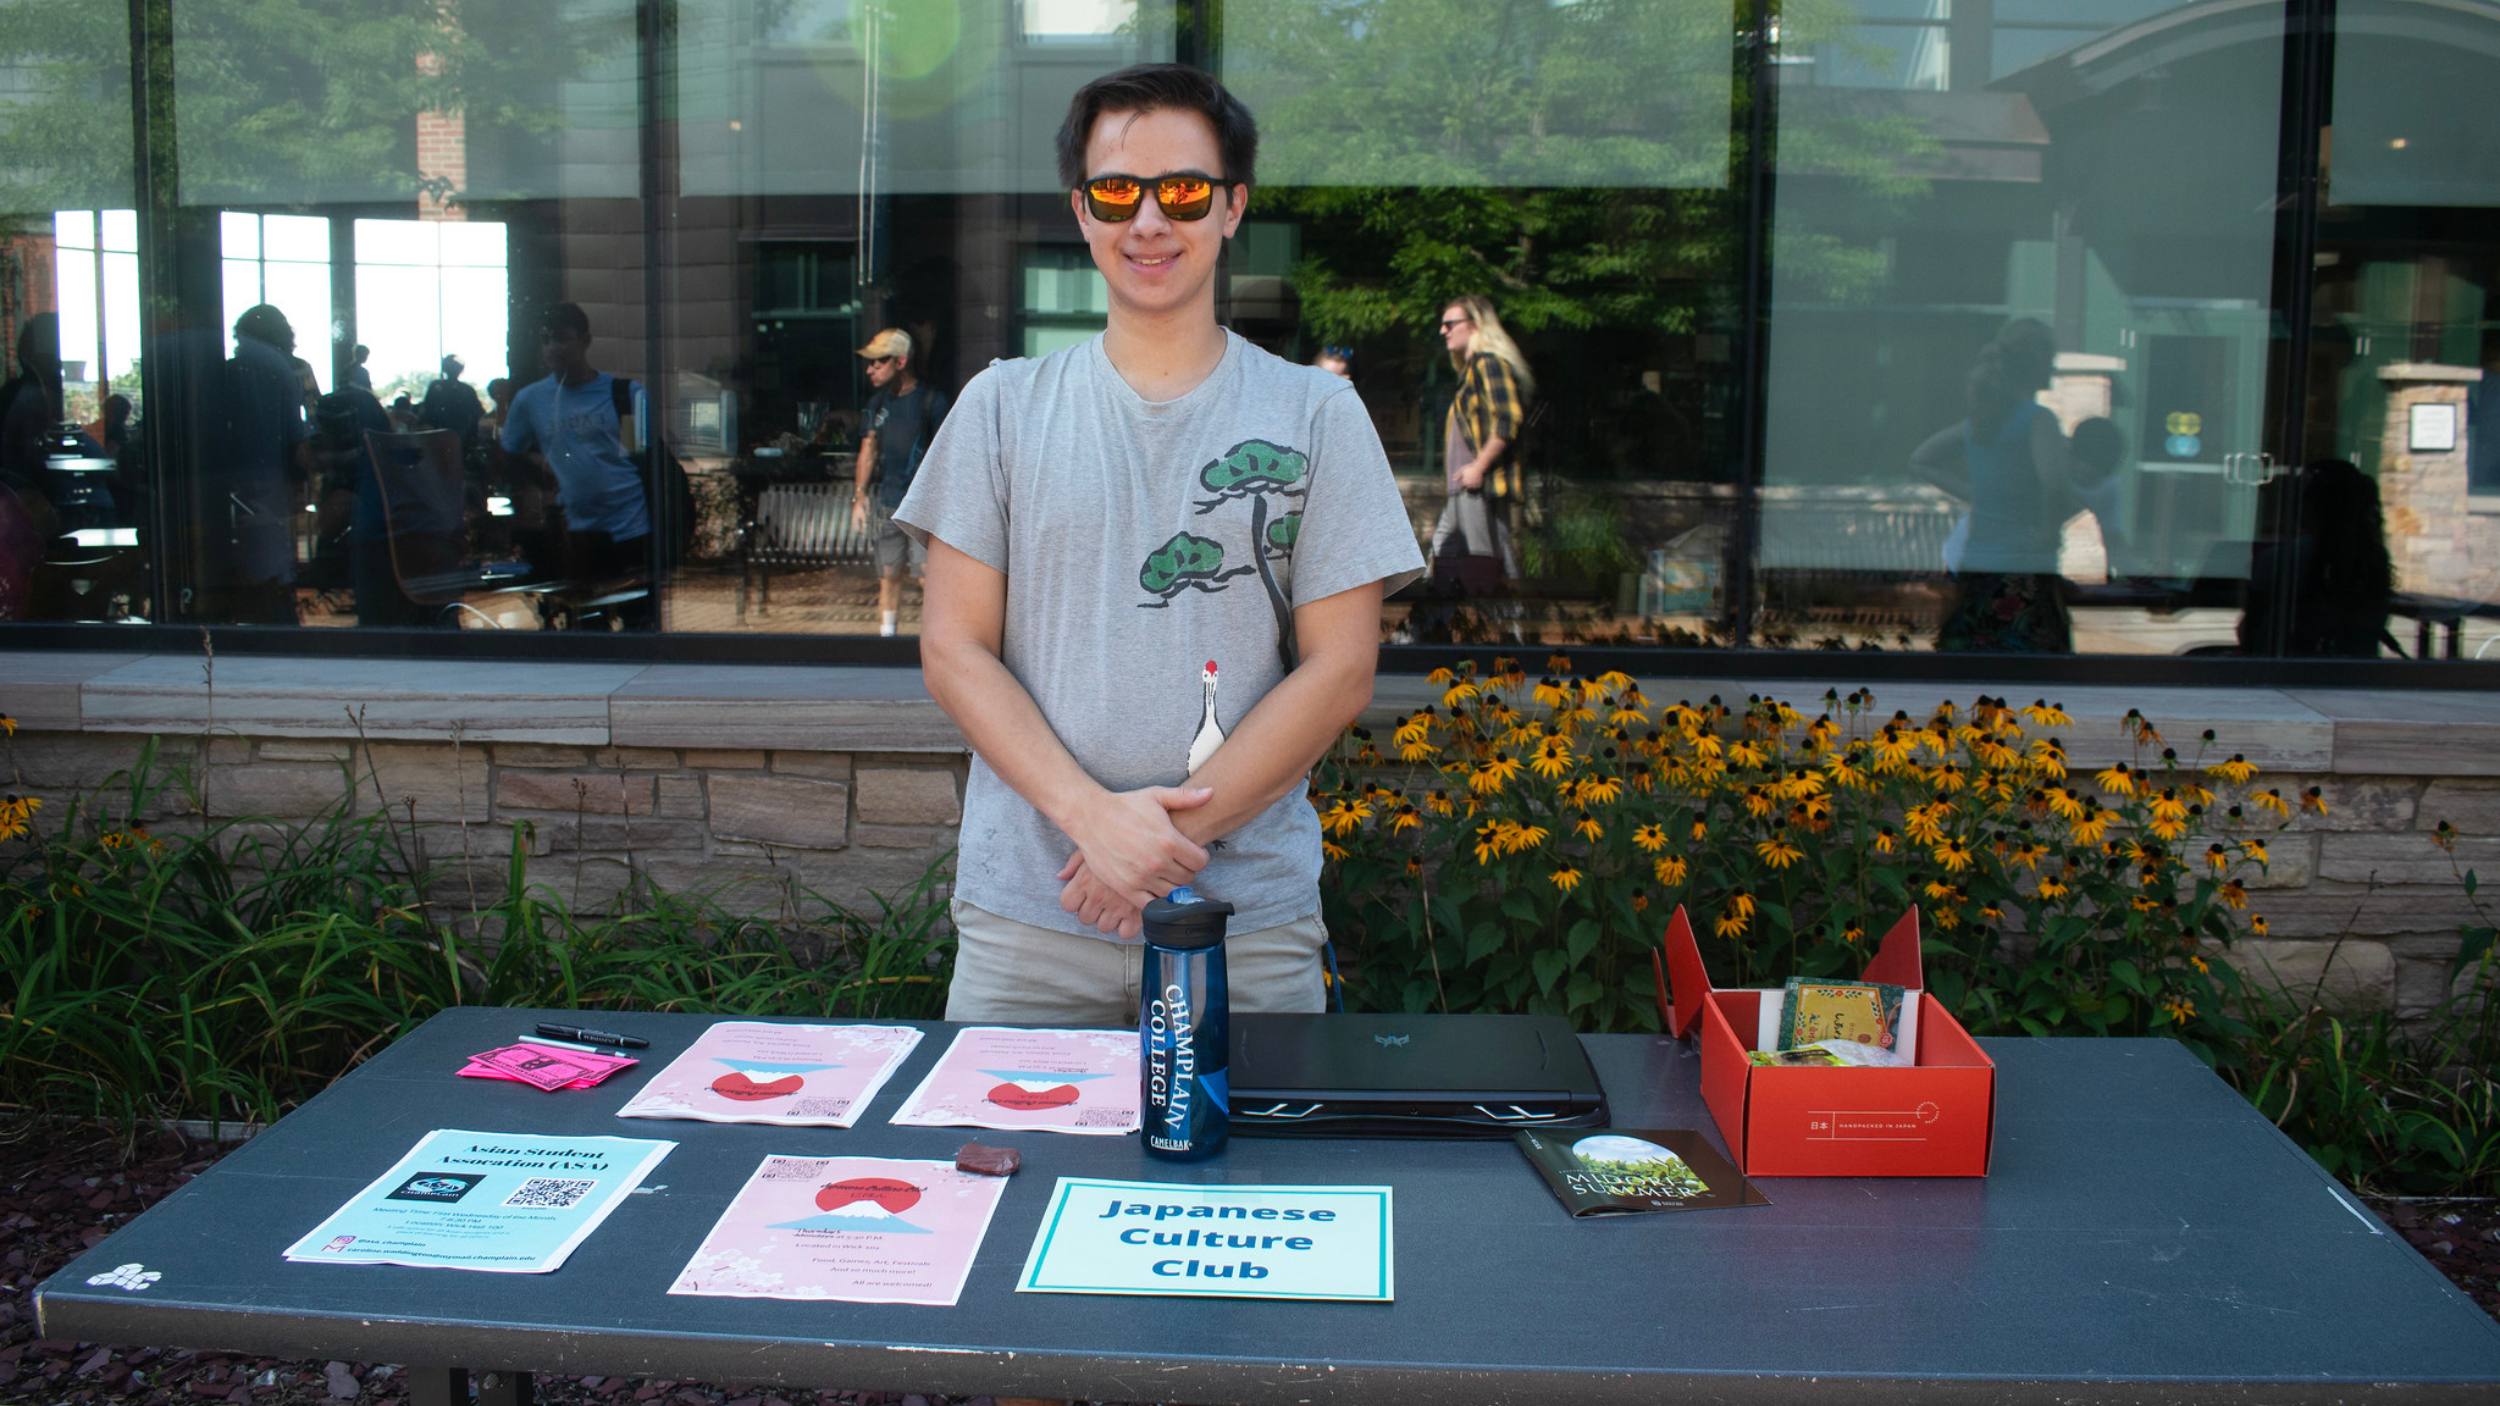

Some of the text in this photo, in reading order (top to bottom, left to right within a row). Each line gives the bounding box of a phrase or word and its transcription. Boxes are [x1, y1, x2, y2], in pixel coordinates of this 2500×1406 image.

[1150, 999, 1167, 1107] COLLEGE
[1165, 983, 1194, 1130] CHAMPLAIN
[1810, 1121, 1829, 1130] 日本
[1150, 1135, 1190, 1151] CAMELBAK
[462, 1144, 605, 1159] Asian Student
[438, 1155, 609, 1171] Assocation (ASA)
[1566, 1173, 1677, 1187] MIDORI
[1572, 1183, 1698, 1198] SUMMER
[1098, 1200, 1337, 1222] Japanese
[1119, 1228, 1315, 1250] Culture
[1151, 1259, 1270, 1280] Club
